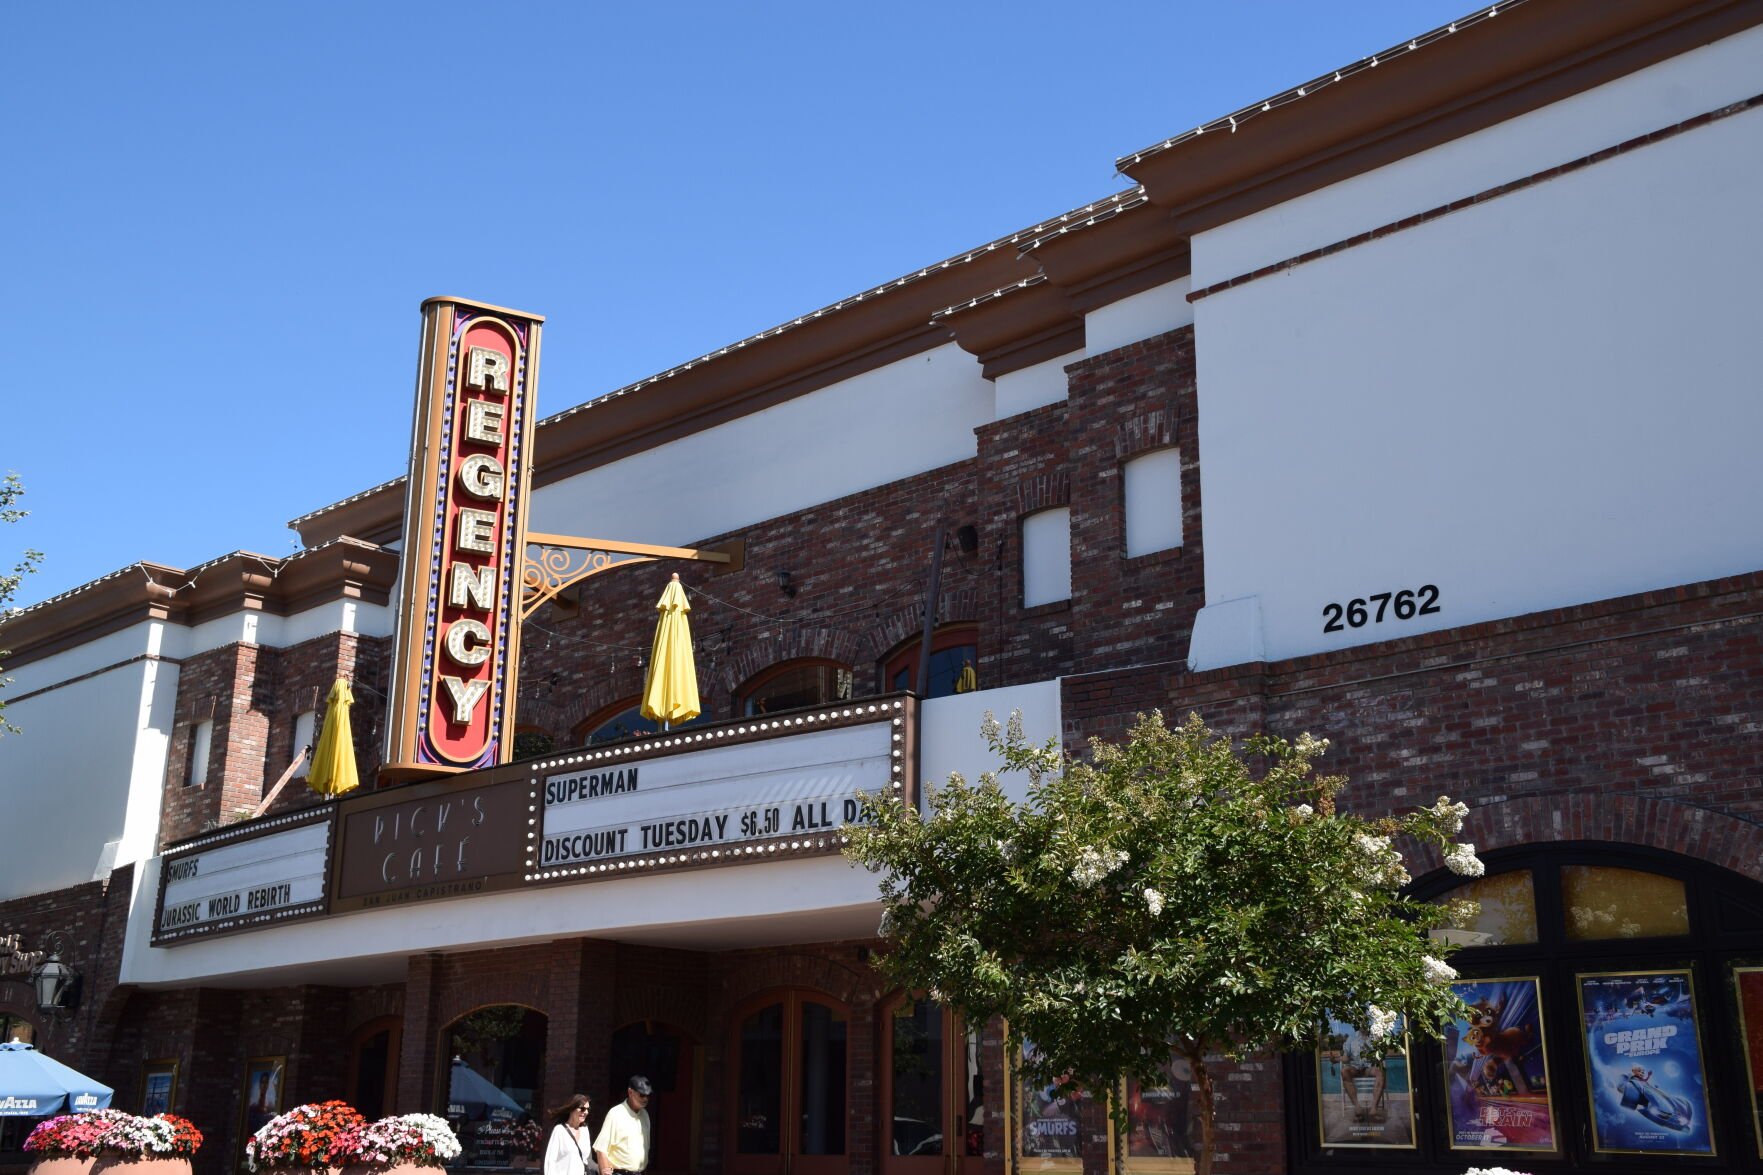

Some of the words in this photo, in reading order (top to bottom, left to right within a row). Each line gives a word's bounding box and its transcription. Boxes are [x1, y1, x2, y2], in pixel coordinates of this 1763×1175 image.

[439, 344, 509, 726] REGENCY
[1322, 584, 1440, 633] 26762
[546, 768, 638, 805] SUPERMAN
[544, 829, 628, 863] DISCOUNT
[641, 815, 728, 849] TUESDAY
[741, 807, 779, 836] $6.50
[792, 802, 832, 831] ALL
[844, 798, 880, 824] DA
[167, 859, 199, 883] SMURFS
[416, 880, 482, 899] CAPISTRANO
[161, 902, 201, 928] JURASSIC
[208, 894, 240, 917] WORLD
[247, 883, 291, 911] REBIRTH
[1604, 1025, 1678, 1045] GRAND
[1616, 1036, 1668, 1054] PRIX
[1029, 1121, 1077, 1136] SMURFS
[1477, 1115, 1533, 1128] TRAIN
